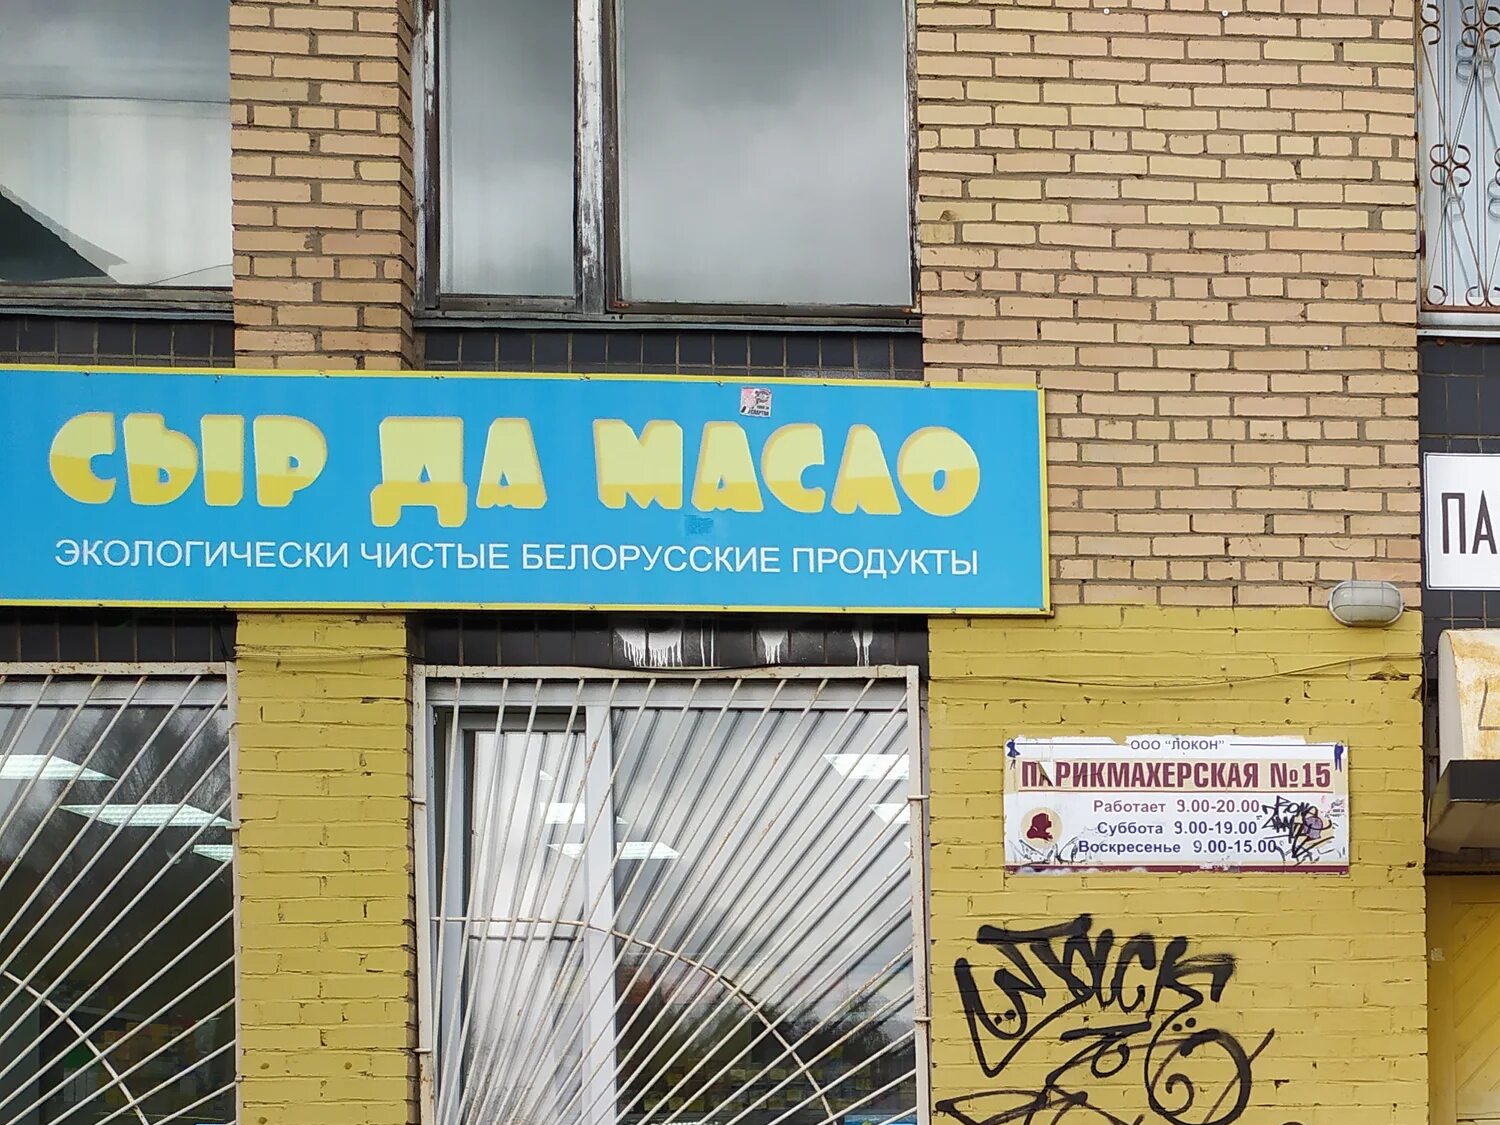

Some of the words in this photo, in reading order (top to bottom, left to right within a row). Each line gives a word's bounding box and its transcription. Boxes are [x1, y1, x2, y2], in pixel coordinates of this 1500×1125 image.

[49, 411, 328, 507] СЫР
[370, 416, 548, 528] ДА
[592, 418, 981, 518] МАСЛО
[55, 538, 349, 569] ЭКОЛОГИЧЕСКИ
[360, 541, 510, 571] ЧИСТЫЕ
[522, 544, 781, 574] БЕЛОРУССКИЕ
[792, 547, 979, 579] ПРОДУКТЫ
[1130, 739, 1161, 750] ООО
[1270, 762, 1331, 788] №15
[1093, 799, 1166, 813] Работает
[1097, 821, 1164, 837] Суббота
[1078, 840, 1181, 856] Воскресенье
[1193, 839, 1276, 854] 9.00-15.00
